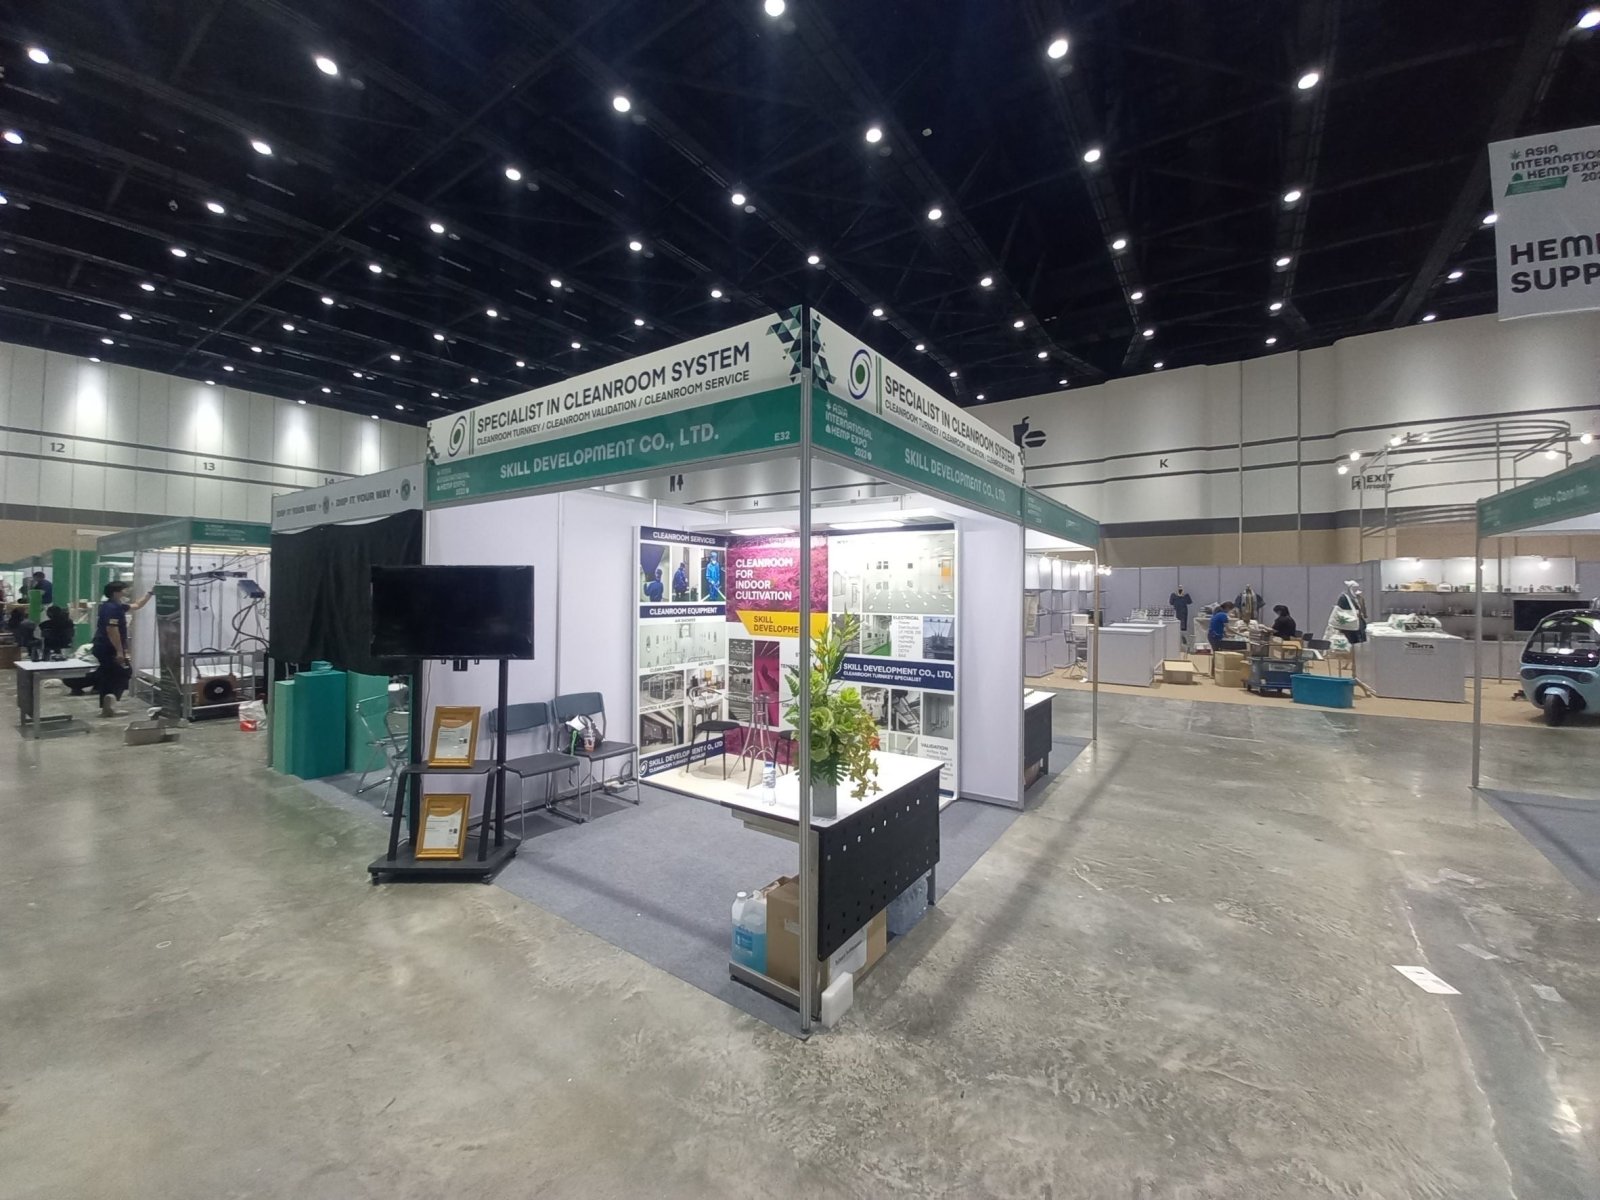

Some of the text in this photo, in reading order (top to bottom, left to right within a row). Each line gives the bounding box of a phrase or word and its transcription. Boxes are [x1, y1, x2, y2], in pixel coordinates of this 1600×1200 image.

[1525, 144, 1558, 158] ASIA
[1527, 161, 1600, 179] HEMP EXP
[478, 342, 750, 434] SPECIALIST IN CLEANROOM SYSTEM
[477, 429, 512, 446] CLEANROOM
[513, 424, 541, 440] TURNKEY
[546, 412, 590, 430] CLEANROOM
[592, 399, 636, 418] VALIDATION
[644, 381, 702, 406] CLEANROOM
[705, 370, 750, 390] SERVICE
[826, 410, 872, 440] INTERNATIONAL
[885, 376, 1015, 465] SPECIALIST IN CLEANROOM SYSTEM
[774, 431, 790, 442] E32
[832, 424, 850, 440] HEMP
[50, 442, 66, 453] 12
[500, 462, 530, 479] SKILL
[534, 438, 635, 473] DEVELOPMENT
[680, 423, 719, 446] LTD.
[204, 462, 216, 471] 13
[1160, 458, 1168, 468] K
[905, 448, 929, 472] SKILL
[930, 459, 982, 492] DEVELOPMENT
[1366, 473, 1395, 482] EXIT
[356, 492, 375, 502] YOUR
[376, 488, 391, 499] WAY
[653, 532, 716, 544] CLEANROOM SERVICES
[736, 558, 794, 568] CLEANROOM
[736, 570, 753, 578] FOR
[736, 580, 771, 590] INDOOR
[736, 591, 792, 600] CULTIVATION
[688, 606, 718, 615] EQUIPMENT
[754, 615, 774, 624] SKILL
[843, 663, 862, 671] SKILL
[863, 664, 918, 676] DEVELOPMENT
[937, 670, 954, 679] LTD.
[649, 757, 664, 767] SKILL
